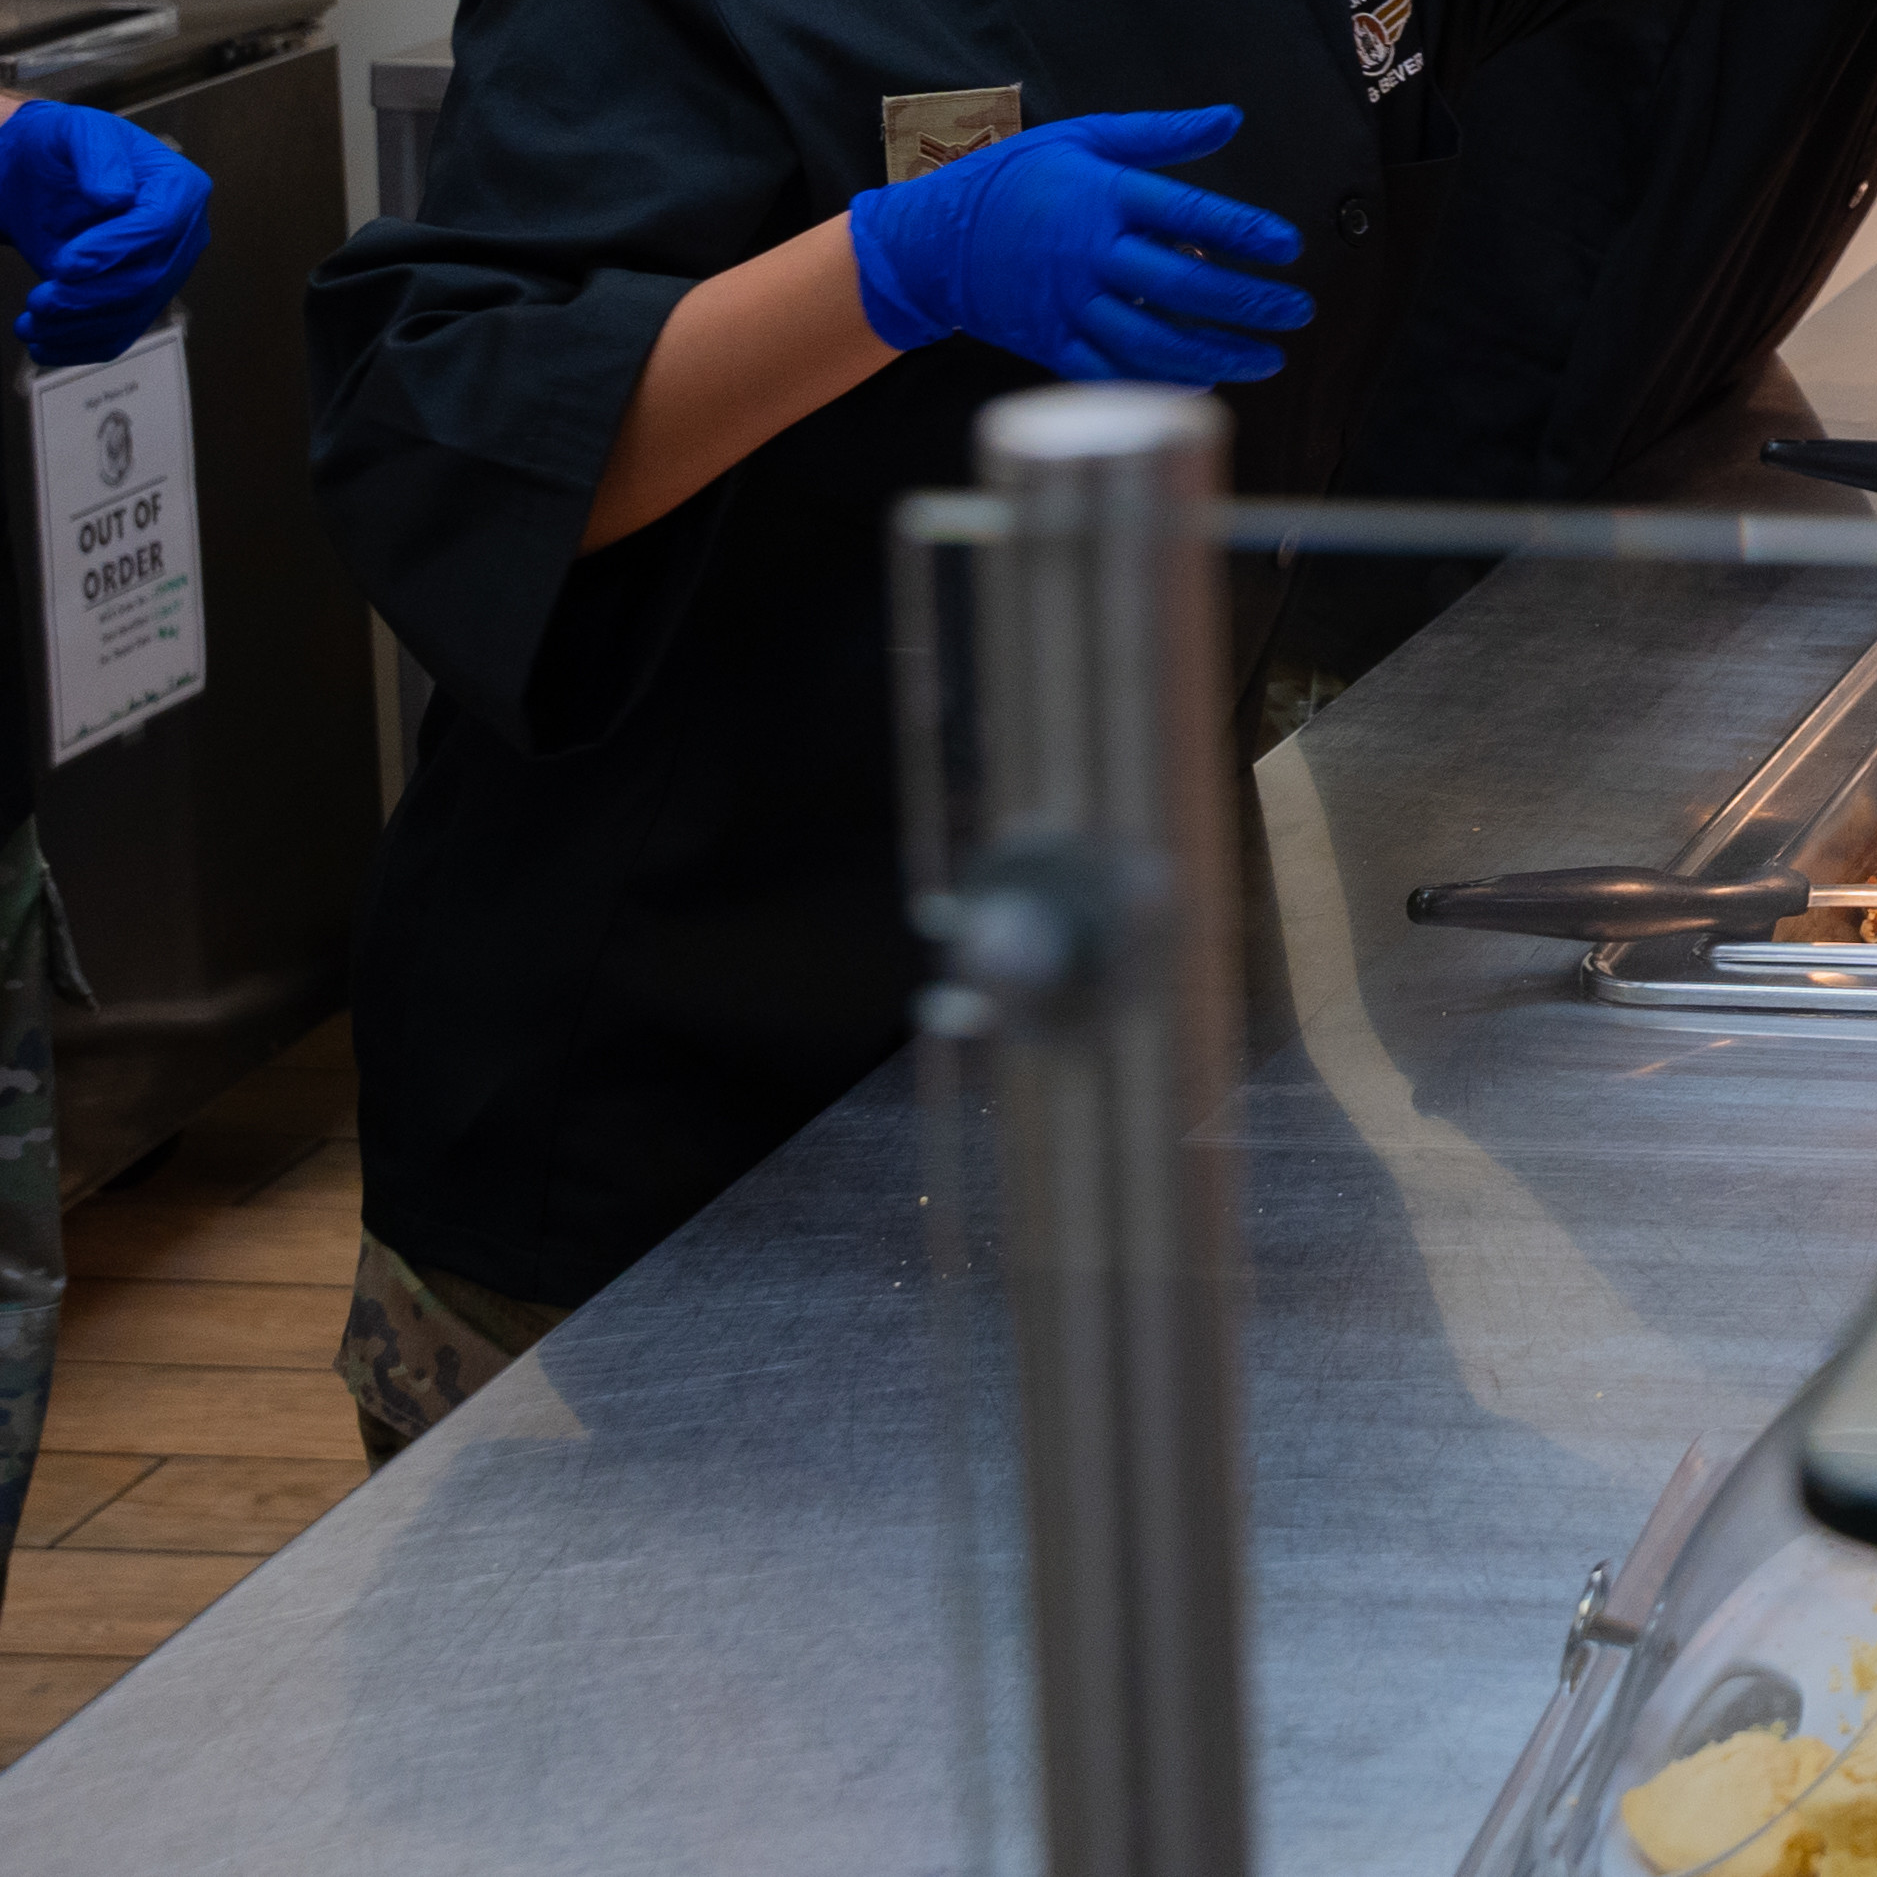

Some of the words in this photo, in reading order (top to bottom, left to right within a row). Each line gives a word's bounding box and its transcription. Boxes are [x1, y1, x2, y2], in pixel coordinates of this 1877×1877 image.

[1377, 51, 1425, 95] BEVER
[78, 505, 127, 557] OUT
[134, 493, 163, 533] OF
[81, 540, 166, 600] ORDER
